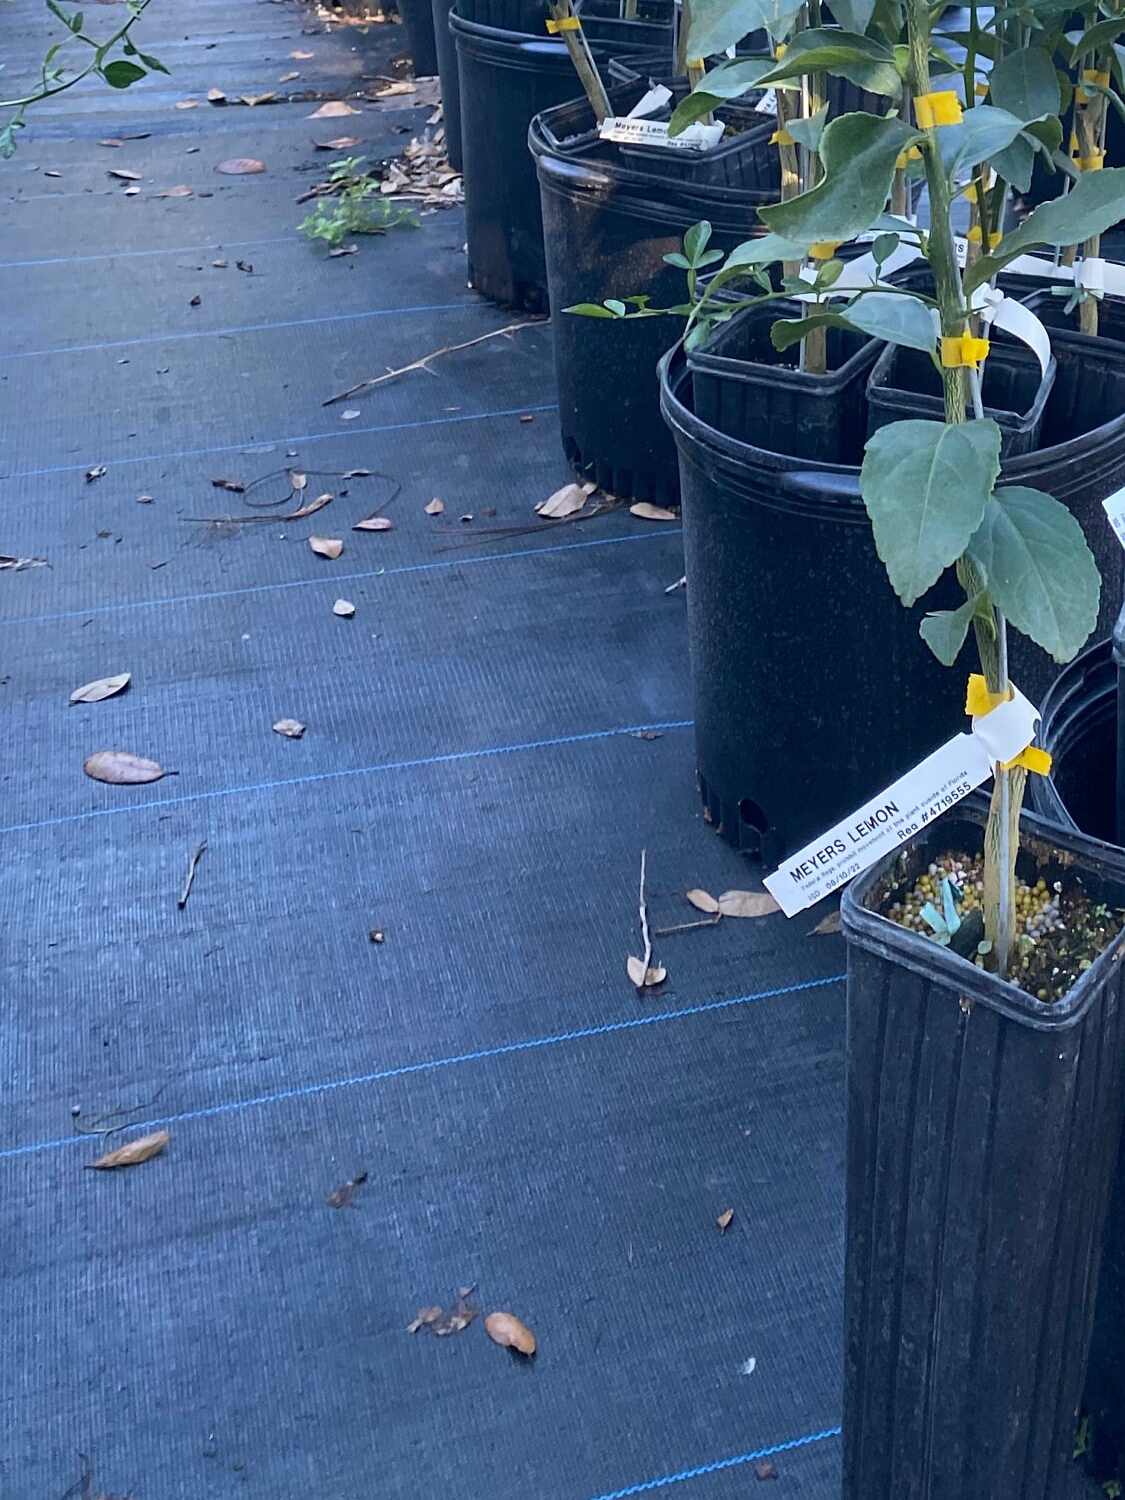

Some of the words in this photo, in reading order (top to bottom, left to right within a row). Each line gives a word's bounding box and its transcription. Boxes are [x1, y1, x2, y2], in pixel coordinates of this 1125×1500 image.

[921, 781, 972, 823] #4719555
[788, 838, 847, 883] MEYERS
[847, 801, 900, 843] LEMON
